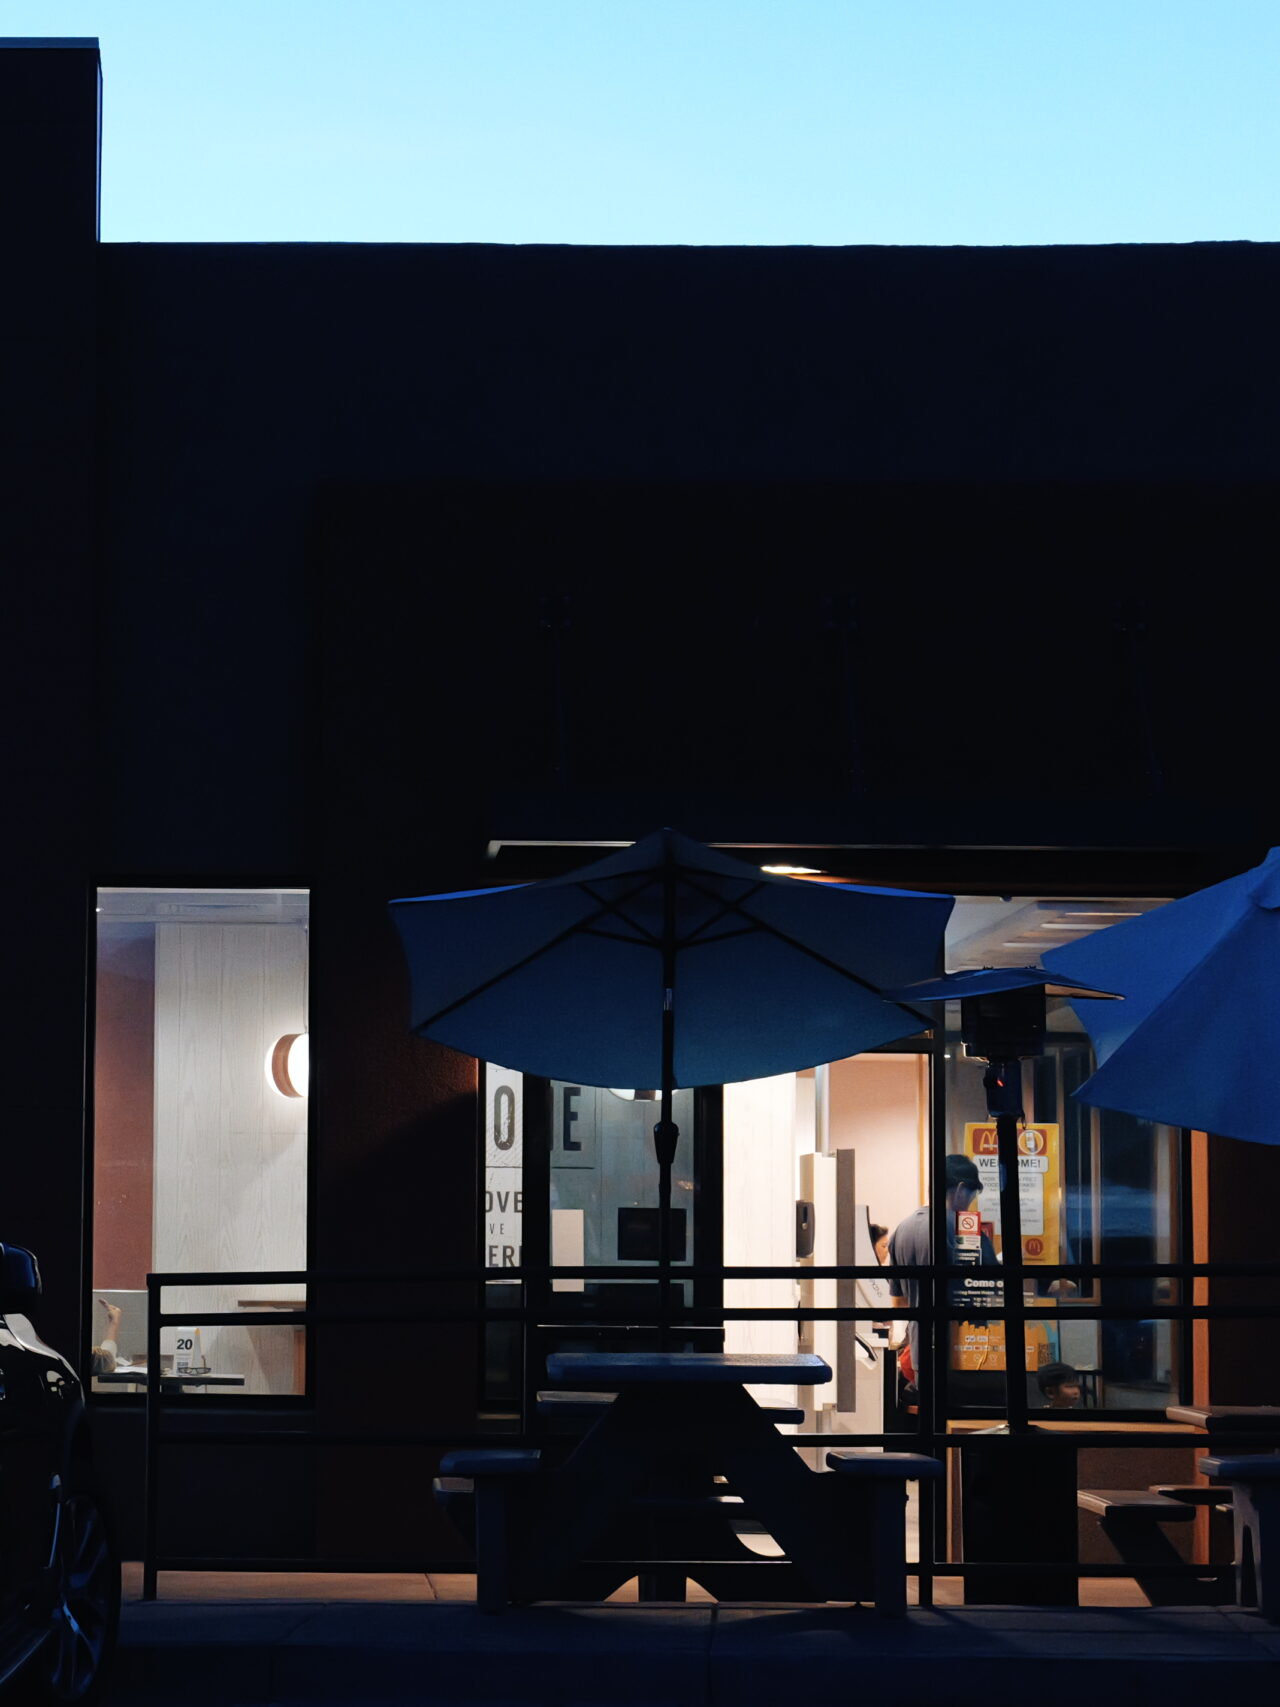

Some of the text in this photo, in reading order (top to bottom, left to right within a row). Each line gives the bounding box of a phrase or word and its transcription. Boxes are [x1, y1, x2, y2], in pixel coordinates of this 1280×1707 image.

[978, 1158, 1041, 1168] WEME!
[489, 1245, 523, 1267] ER
[964, 1278, 995, 1288] Come
[176, 1338, 193, 1350] 20
